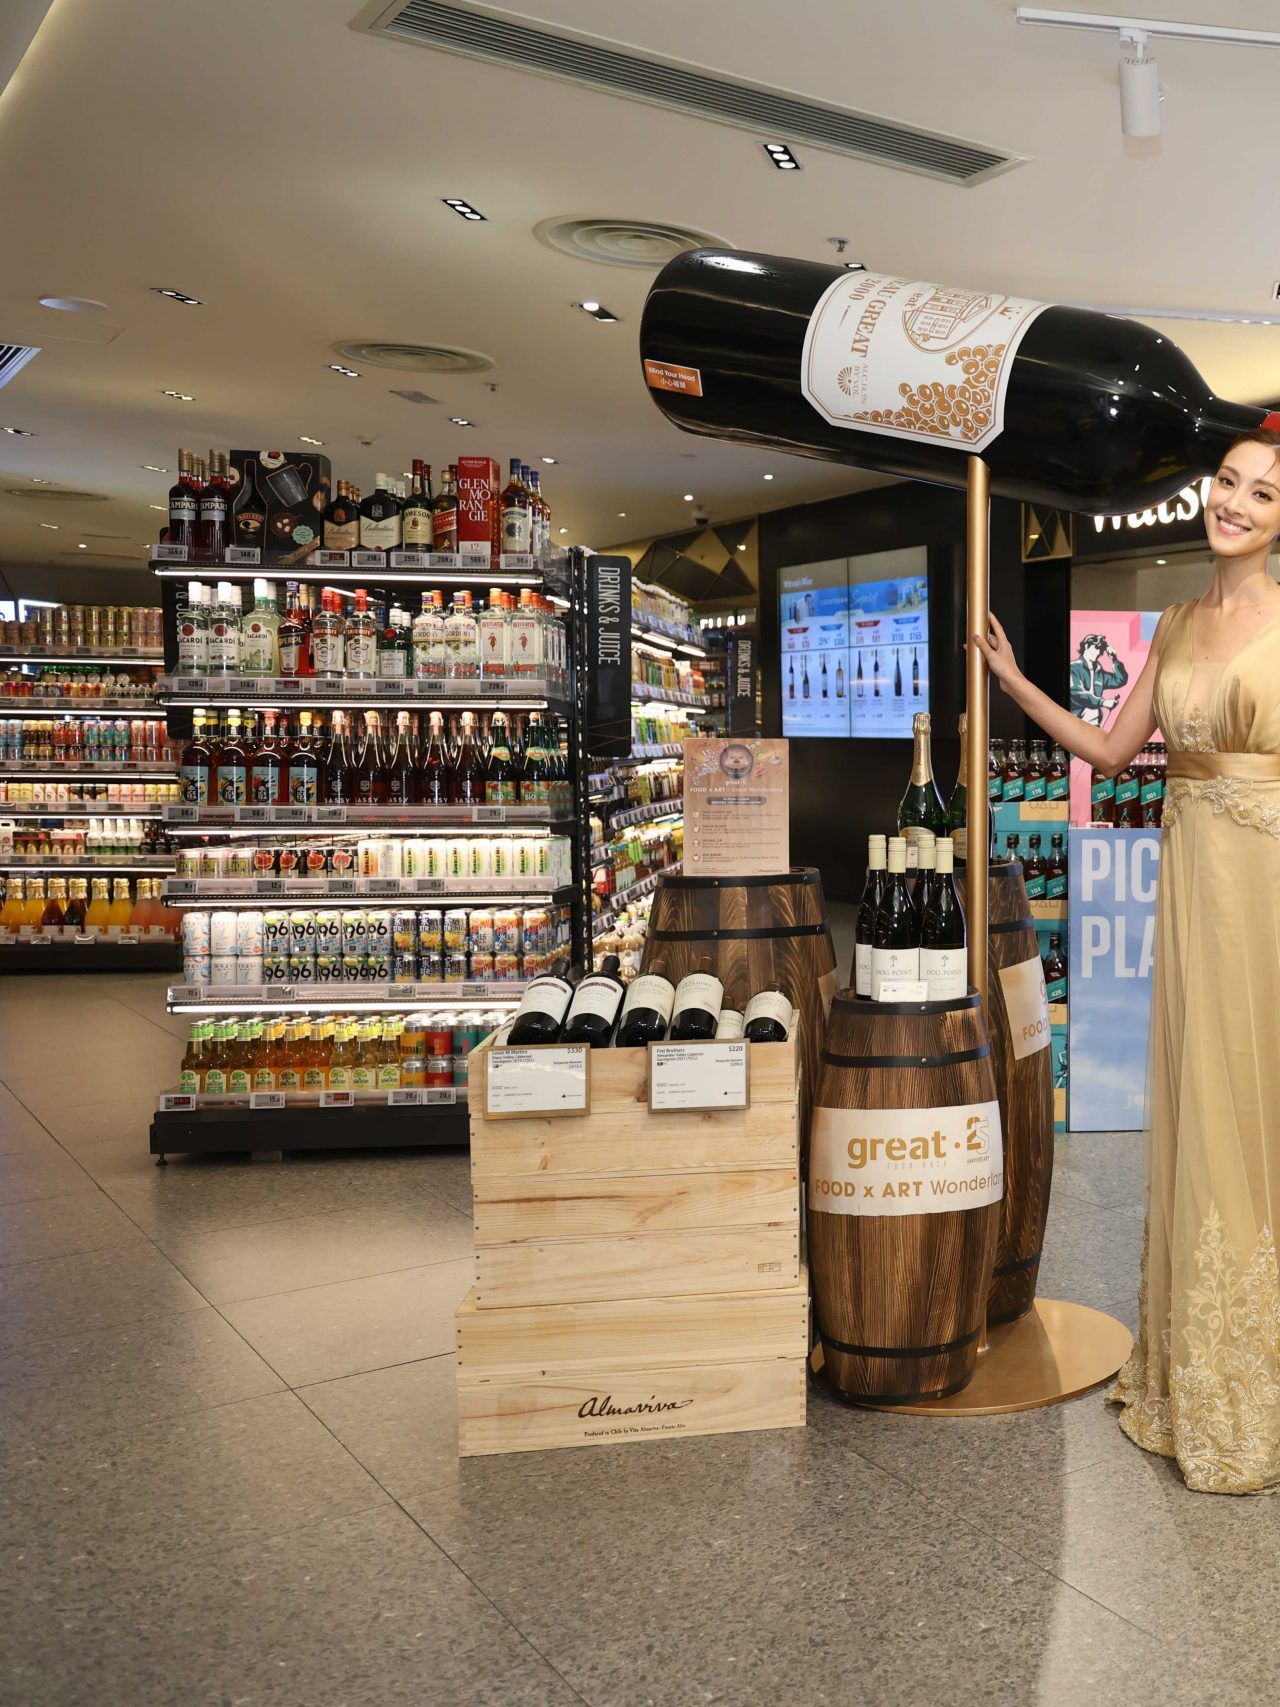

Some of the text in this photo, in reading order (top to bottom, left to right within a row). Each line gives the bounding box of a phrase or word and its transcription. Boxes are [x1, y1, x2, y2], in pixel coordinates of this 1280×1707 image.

[850, 299, 887, 359] GREAT
[648, 366, 696, 382] Mind Your Head
[459, 478, 490, 489] GLEN
[469, 489, 491, 500] MO
[459, 500, 483, 511] RAN
[468, 510, 489, 522] GIE
[598, 566, 621, 614] DRINKS
[598, 627, 621, 666] JUICE
[737, 639, 751, 667] DRINKS
[737, 674, 751, 698] JUICE
[1022, 1018, 1048, 1041] FOOD
[847, 1131, 946, 1169] great
[815, 1178, 855, 1197] FOOD
[863, 1185, 874, 1198] x
[882, 1181, 923, 1198] ART
[578, 1394, 694, 1419] Almaviva
